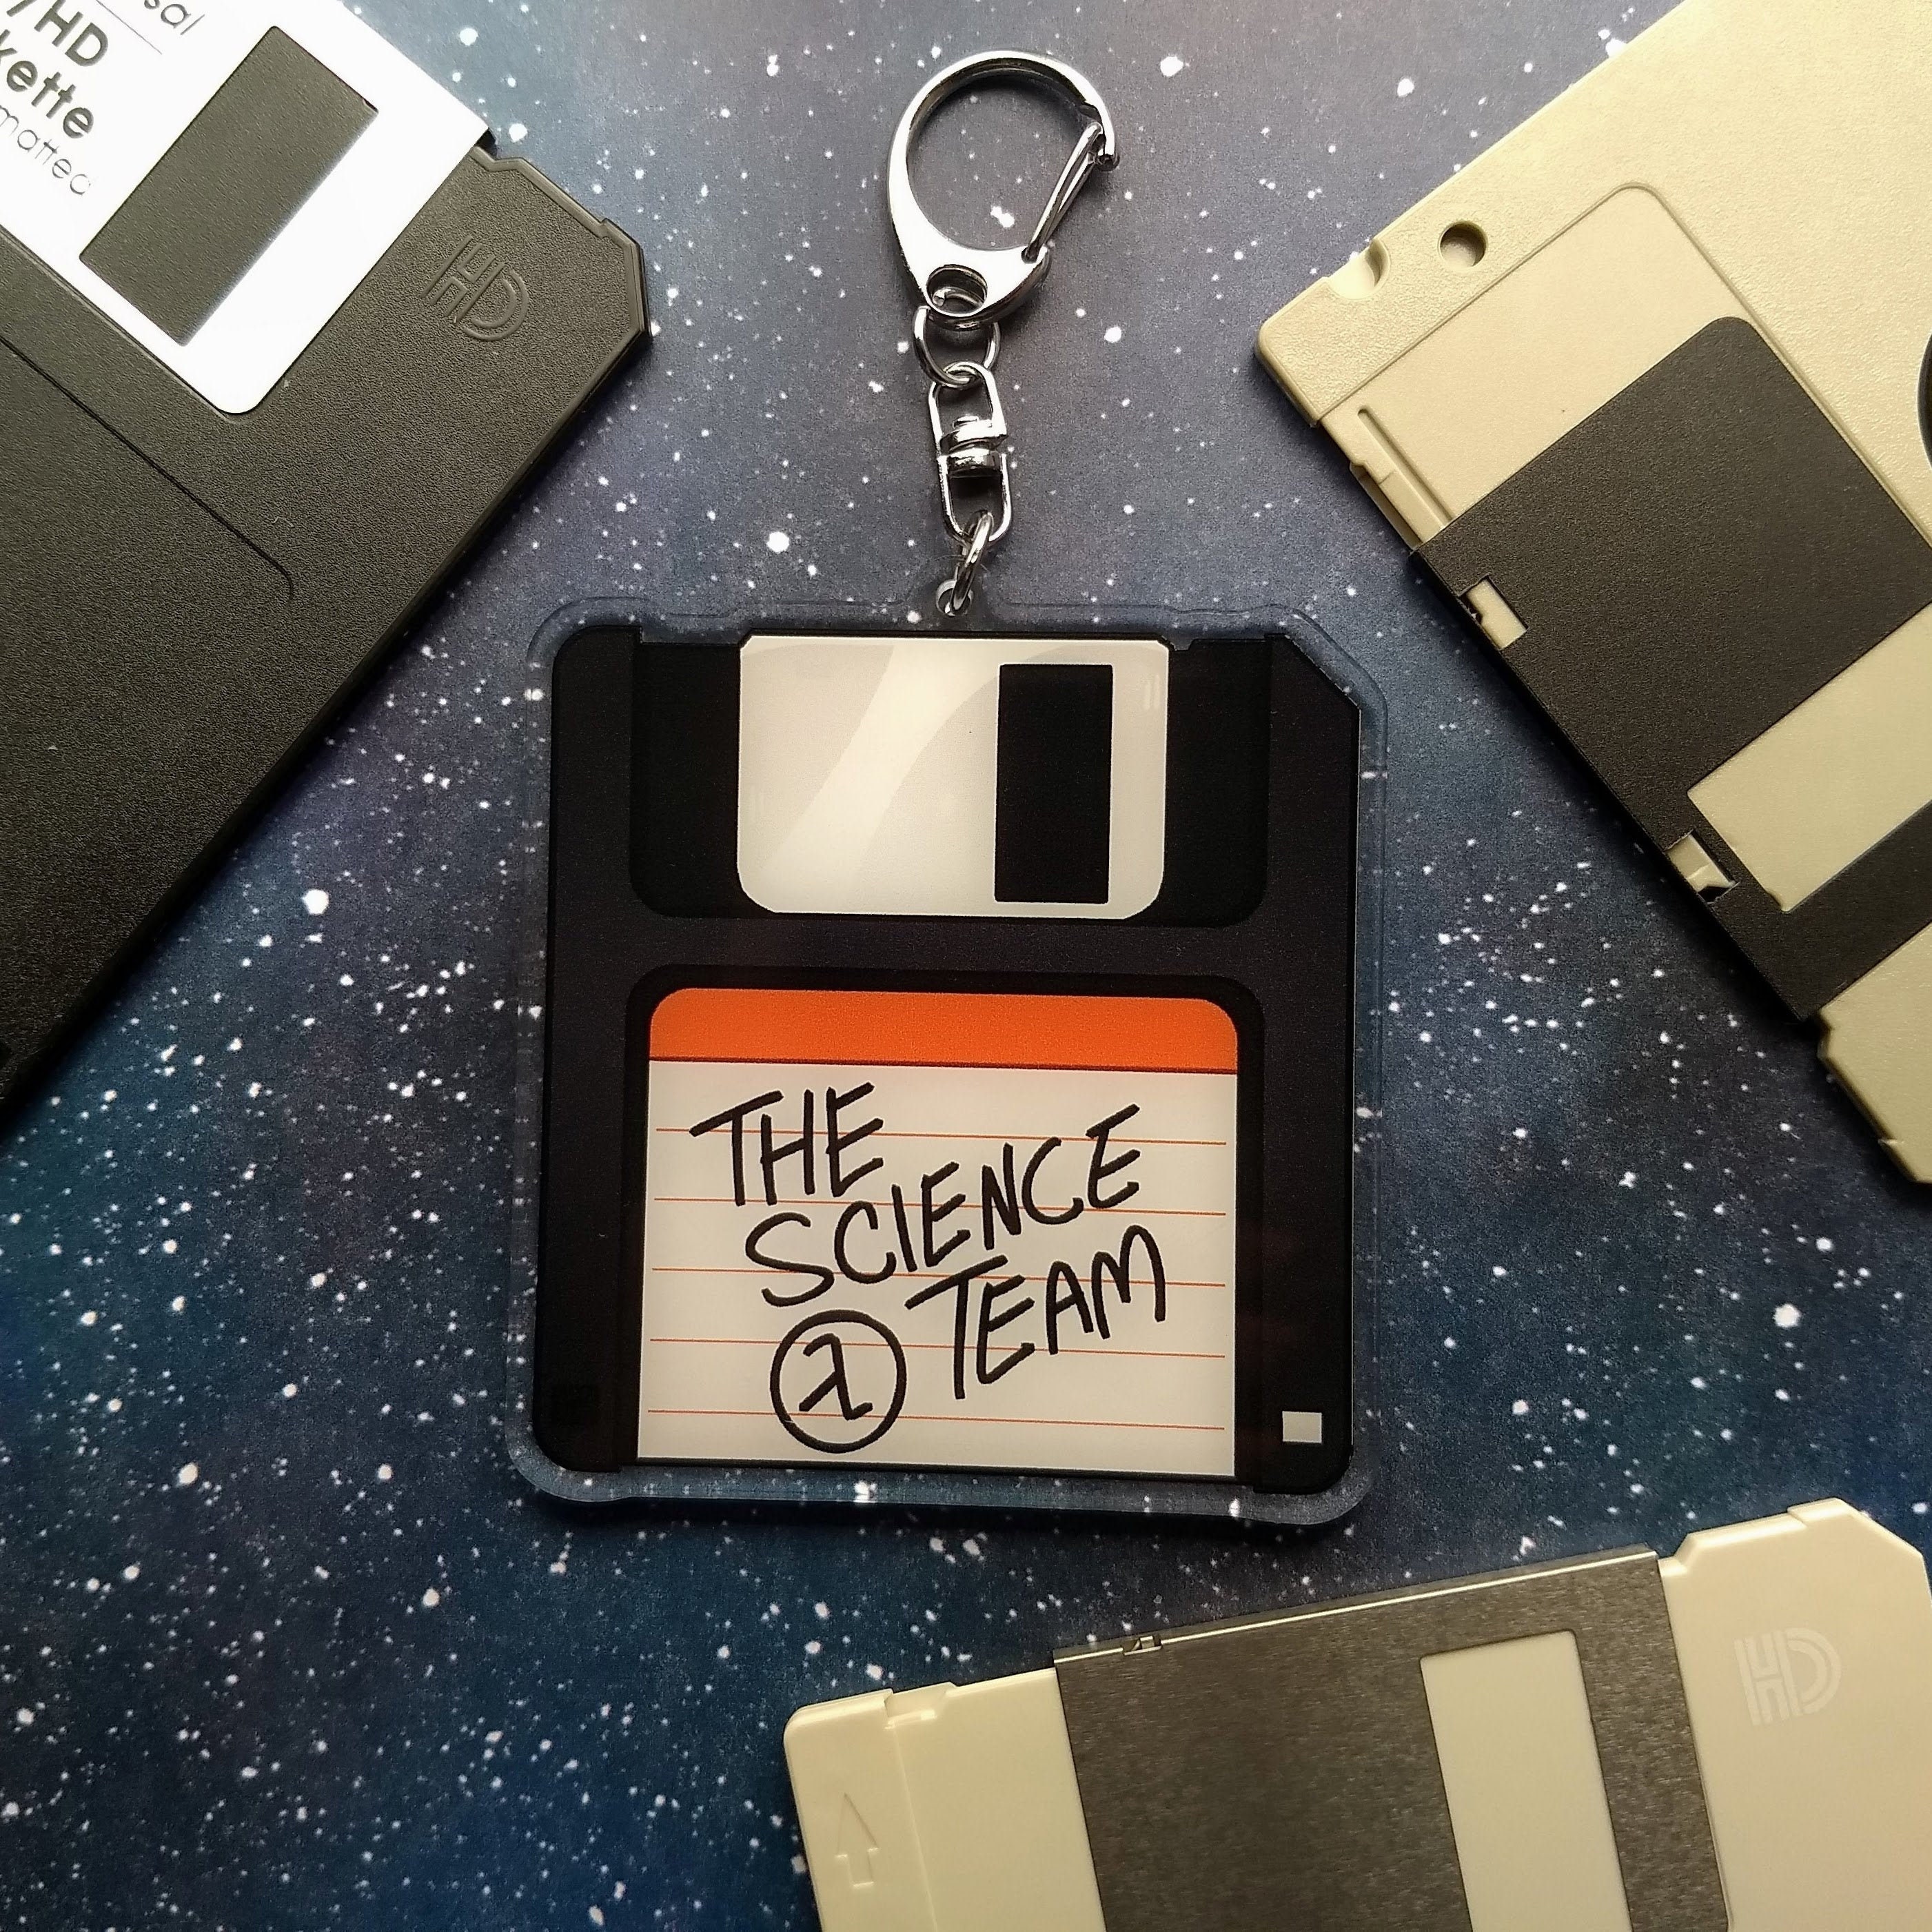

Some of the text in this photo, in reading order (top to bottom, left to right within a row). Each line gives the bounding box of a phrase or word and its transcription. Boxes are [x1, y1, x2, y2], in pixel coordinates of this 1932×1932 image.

[143, 0, 205, 35] al
[418, 236, 529, 341] HD
[689, 1082, 884, 1206] THE
[745, 1104, 1141, 1308] SCIENCE
[904, 1224, 1166, 1400] TEAM
[1733, 1627, 1842, 1726] HD
